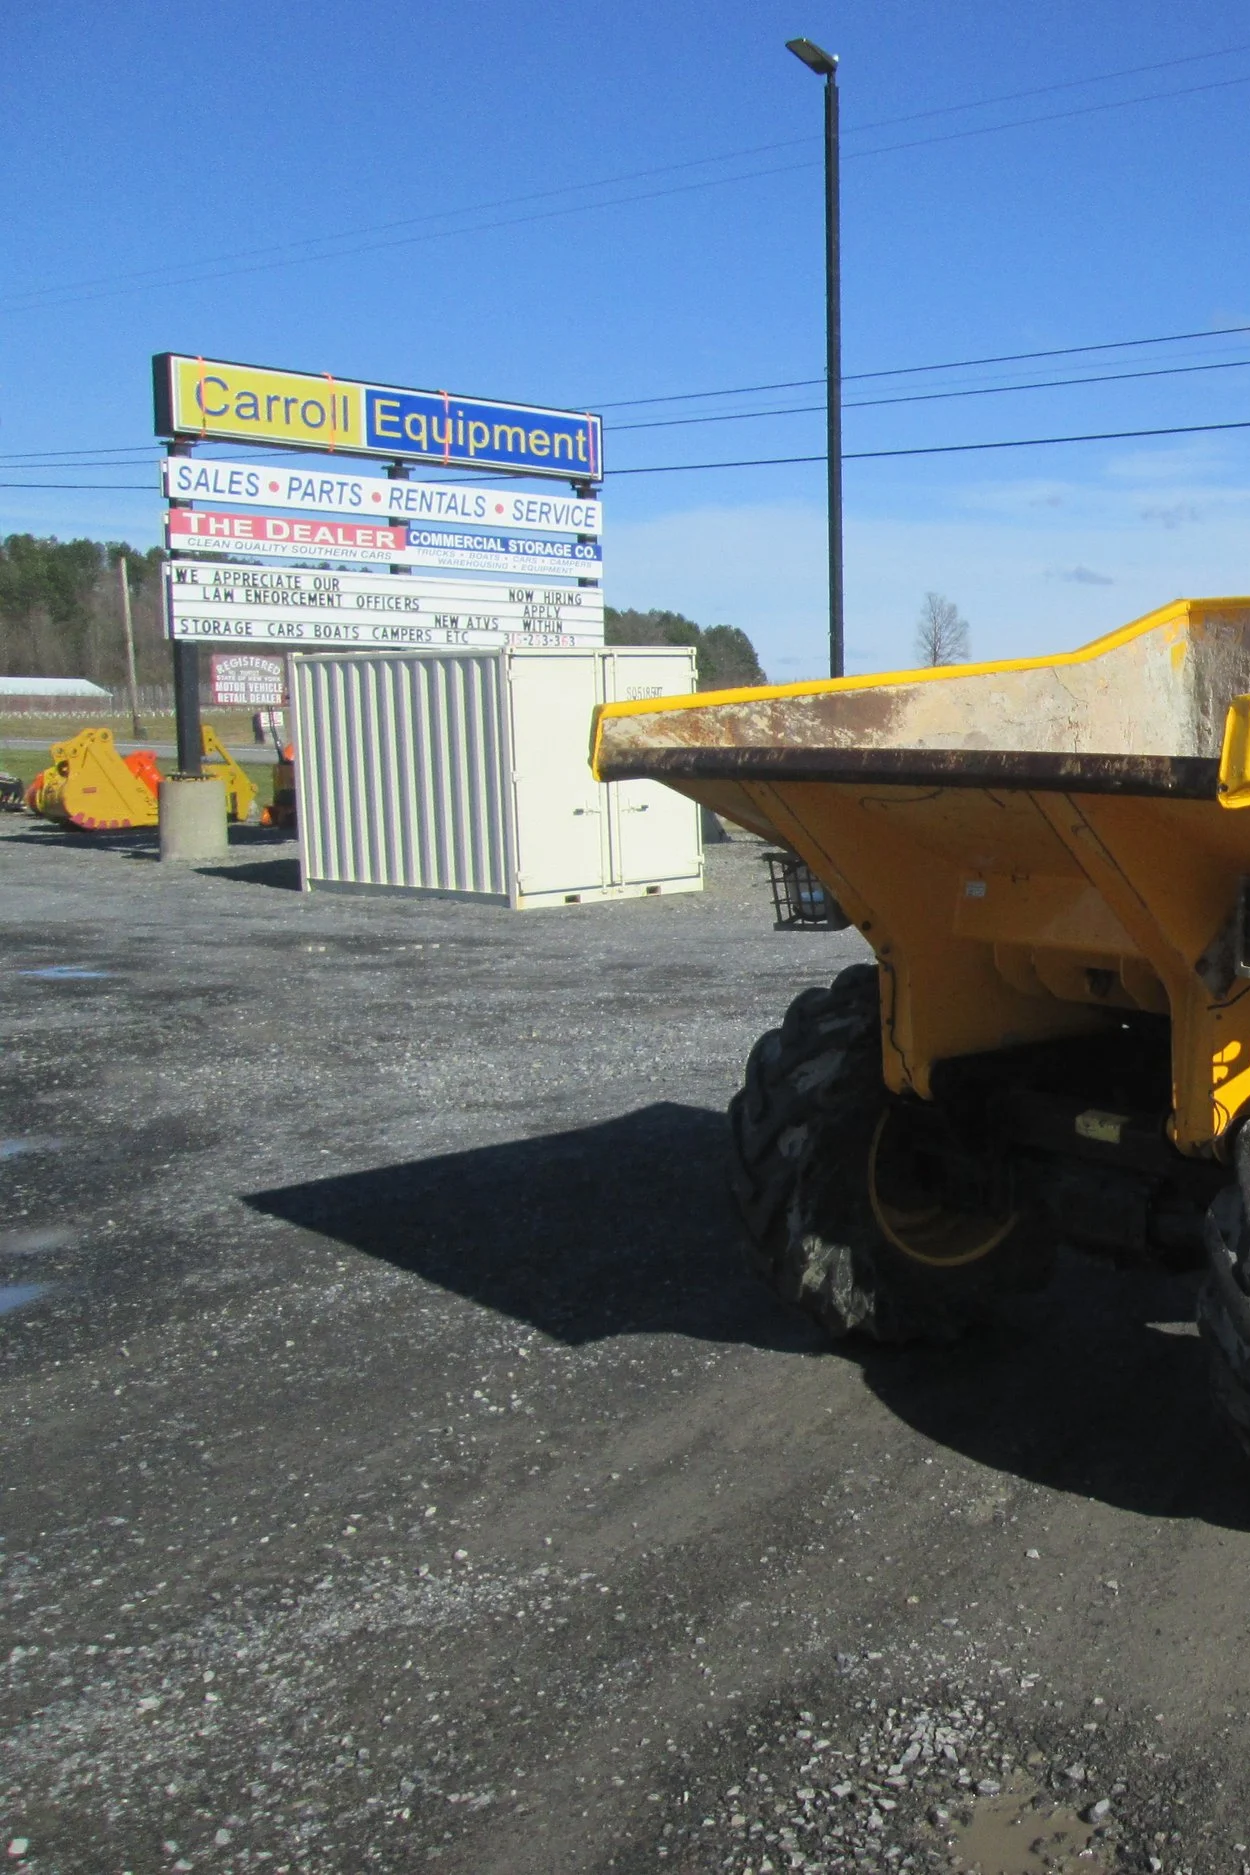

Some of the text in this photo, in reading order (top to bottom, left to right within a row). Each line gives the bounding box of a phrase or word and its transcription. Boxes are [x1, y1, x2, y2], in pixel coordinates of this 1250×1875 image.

[195, 376, 589, 462] Carroll Equipment
[177, 465, 597, 528] SALES PARTS RENTALS SERVICE
[182, 512, 396, 548] THE DEALER
[187, 537, 393, 561] CLEAN QUALITY SOUTHERN CARS
[409, 531, 598, 560] COMMERCIAL STORAGE CO.
[416, 548, 593, 569] TRUCKS BOATS CARS CAMPERS
[437, 557, 574, 575] WAREHOUSING EQUIPMENT
[175, 568, 341, 592] WE APPRECIATE OUR
[202, 586, 421, 612] LAW ENFORCEMENT OFFICERS
[508, 588, 583, 607] NOW HIRING
[434, 614, 500, 630] NEW ATVS
[523, 605, 562, 619] APPLY
[179, 618, 470, 645] STORAGE CARS BOATS CAMPERS ETC
[522, 619, 564, 634] WITHIN
[216, 656, 281, 675] REGISTERED
[215, 681, 284, 693] MOTOR VEHICLE
[217, 692, 282, 704] RETAIL DEALER
